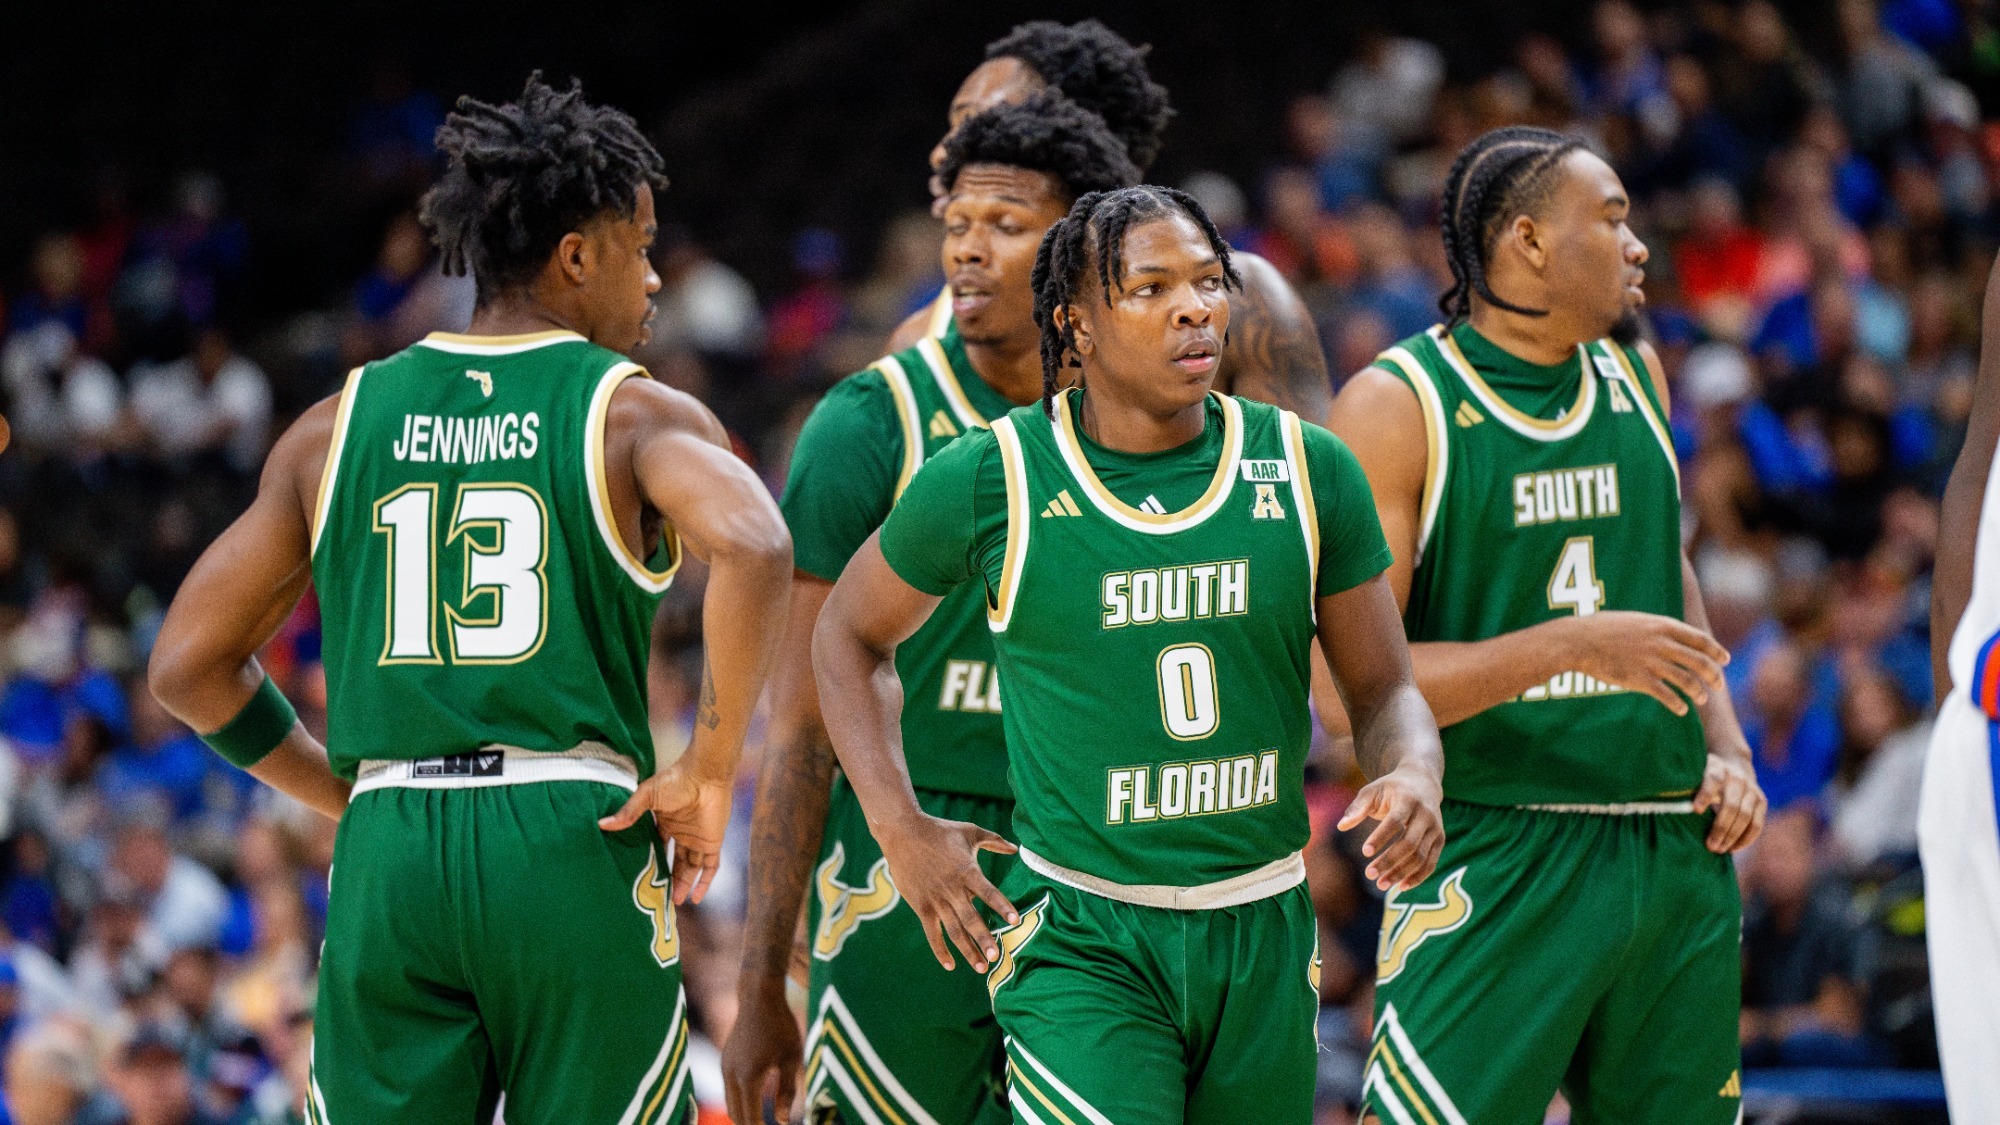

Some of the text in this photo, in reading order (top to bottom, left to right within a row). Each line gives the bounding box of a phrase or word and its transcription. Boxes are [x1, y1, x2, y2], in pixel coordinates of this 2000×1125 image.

[393, 412, 539, 464] JENNINGS
[1251, 462, 1281, 480] AAR
[1513, 463, 1620, 527] SOUTH
[372, 482, 549, 666] 13
[1102, 558, 1249, 629] SOUTH
[1547, 535, 1605, 617] 4
[1156, 642, 1220, 741] 0
[1106, 750, 1278, 825] FLORIDA
